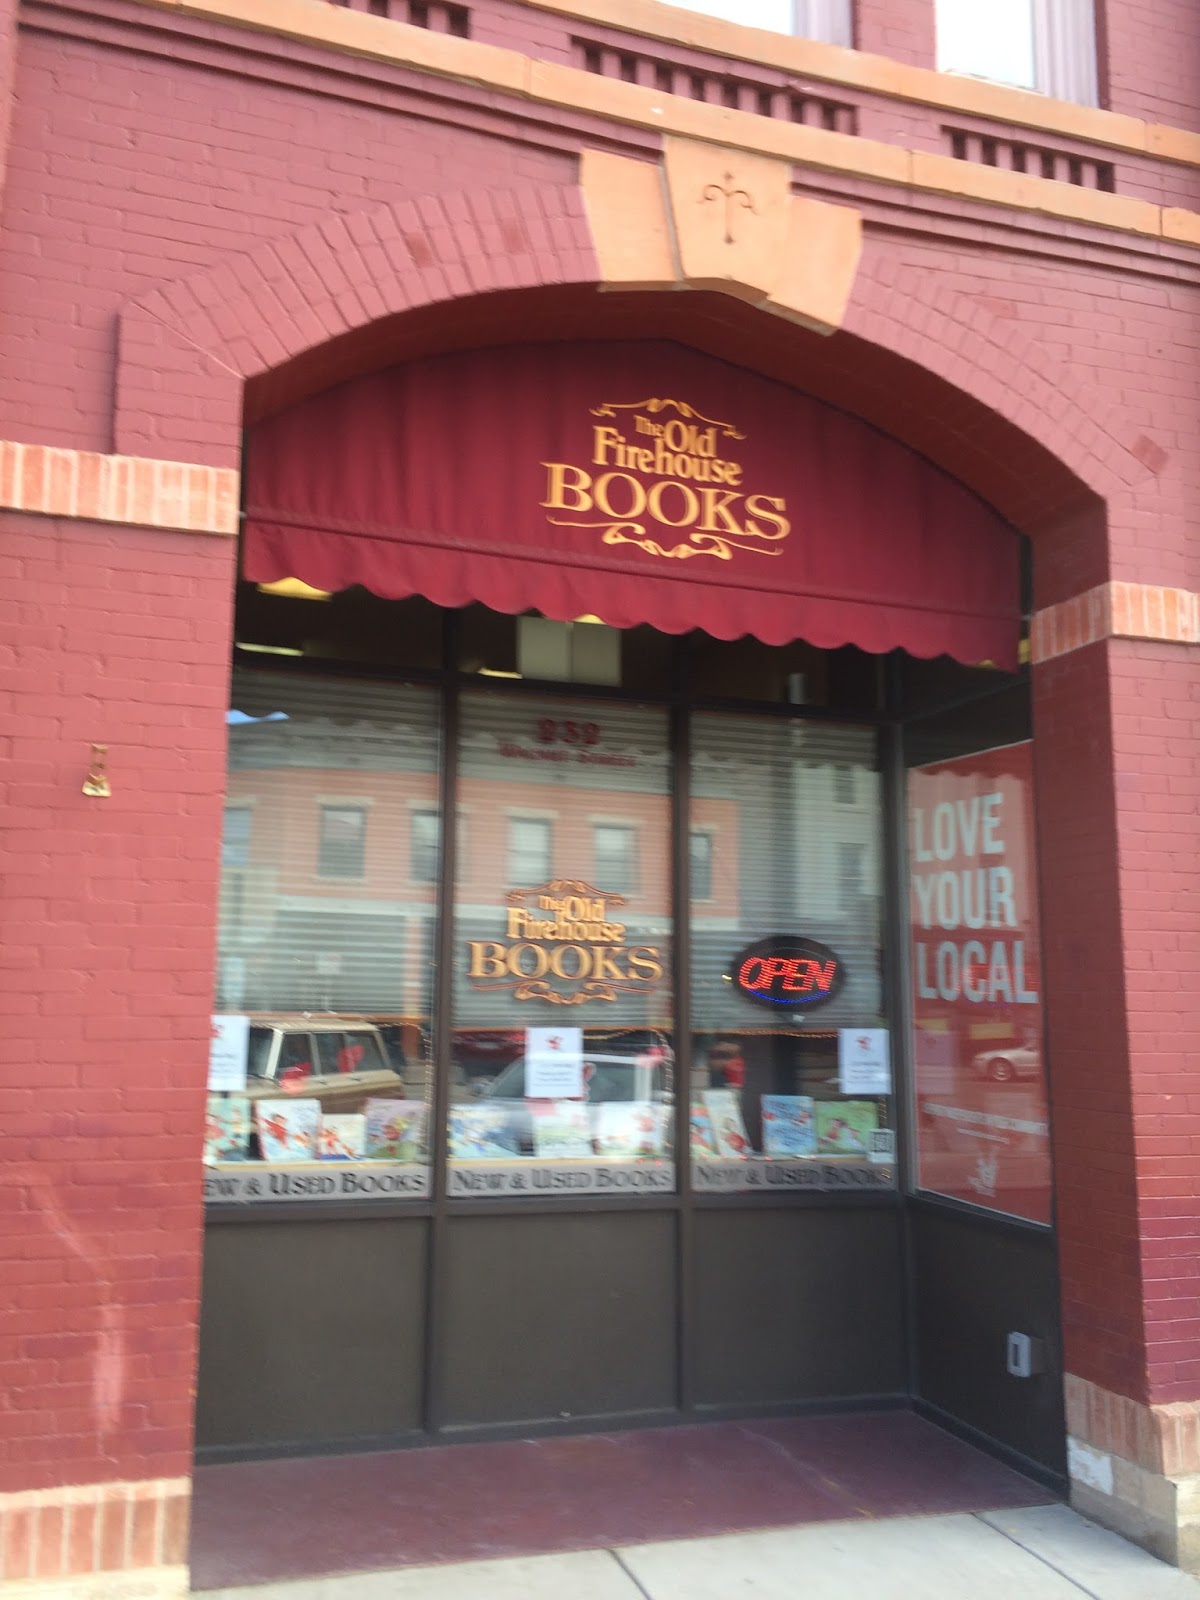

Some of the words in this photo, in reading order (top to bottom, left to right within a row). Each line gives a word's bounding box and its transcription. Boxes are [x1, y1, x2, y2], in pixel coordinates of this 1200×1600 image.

[592, 425, 743, 486] Firehouse
[633, 415, 664, 437] The
[663, 419, 718, 458] Old
[539, 462, 791, 540] BOOKS
[913, 792, 1005, 862] LOVE
[538, 895, 566, 911] The
[565, 895, 607, 922] Old
[913, 866, 1018, 930] YOUR
[506, 907, 627, 942] Firehouse
[466, 940, 664, 982] BOOKS
[738, 956, 837, 991] OPEN
[915, 940, 1039, 1004] LOCAL
[204, 1177, 239, 1197] EW
[339, 1171, 426, 1194] BOOKS
[593, 1167, 674, 1188] BOOKS
